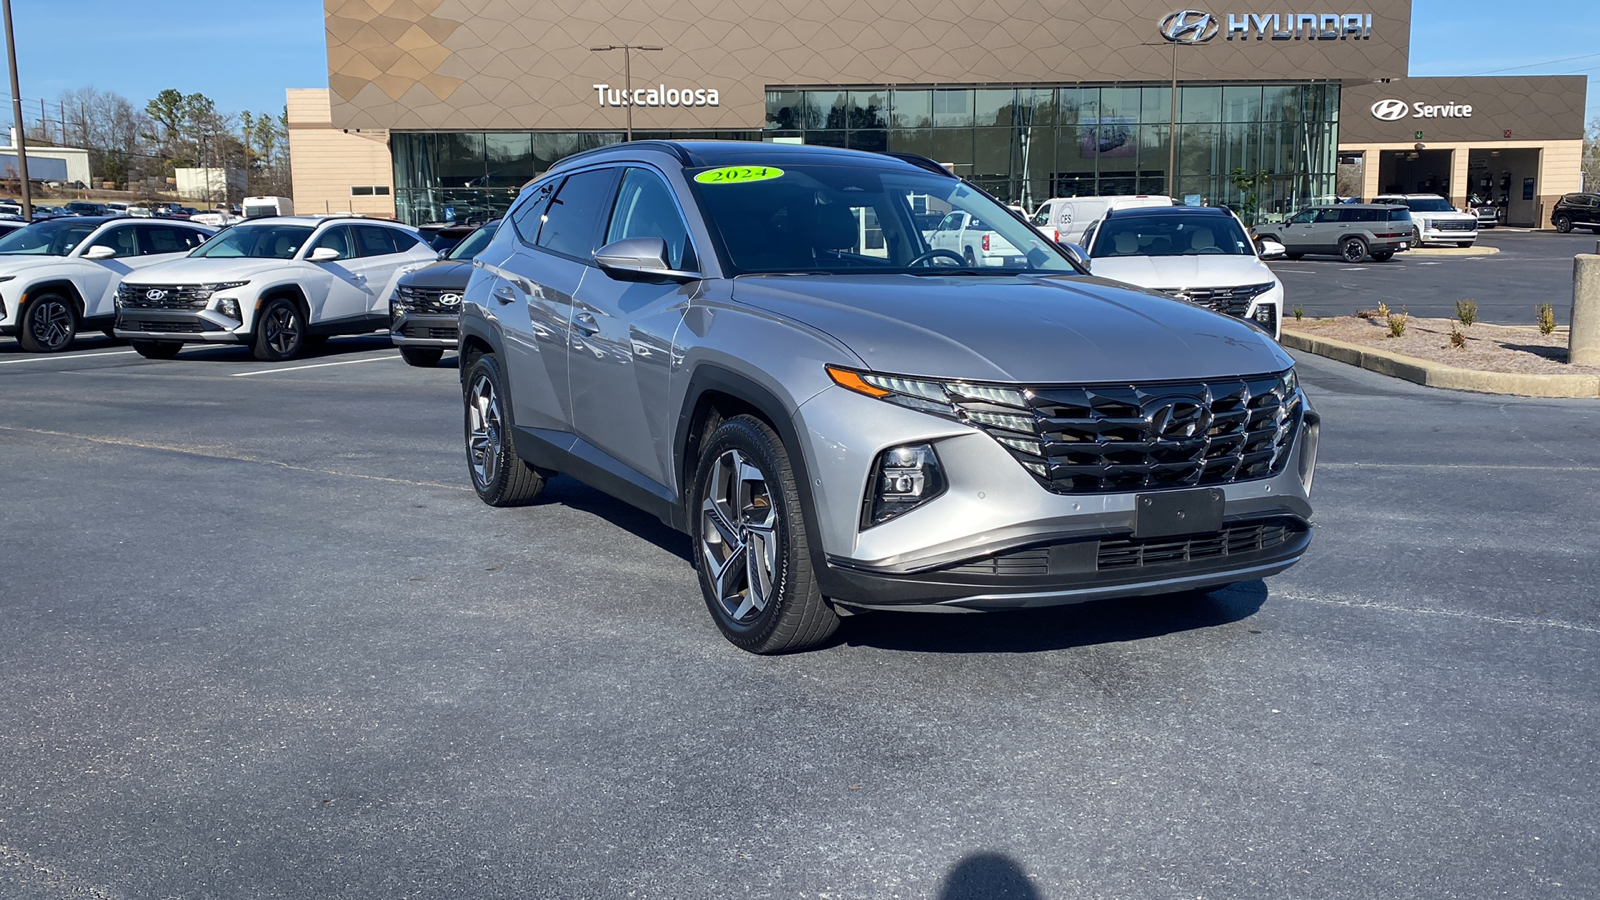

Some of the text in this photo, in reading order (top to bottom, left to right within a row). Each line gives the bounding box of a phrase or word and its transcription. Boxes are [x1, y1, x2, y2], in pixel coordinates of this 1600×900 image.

[1227, 13, 1372, 40] HYUNDAI
[593, 84, 719, 106] Tuscaloosa
[1412, 101, 1473, 118] Service
[712, 168, 768, 182] 2024
[1060, 214, 1072, 224] CES
